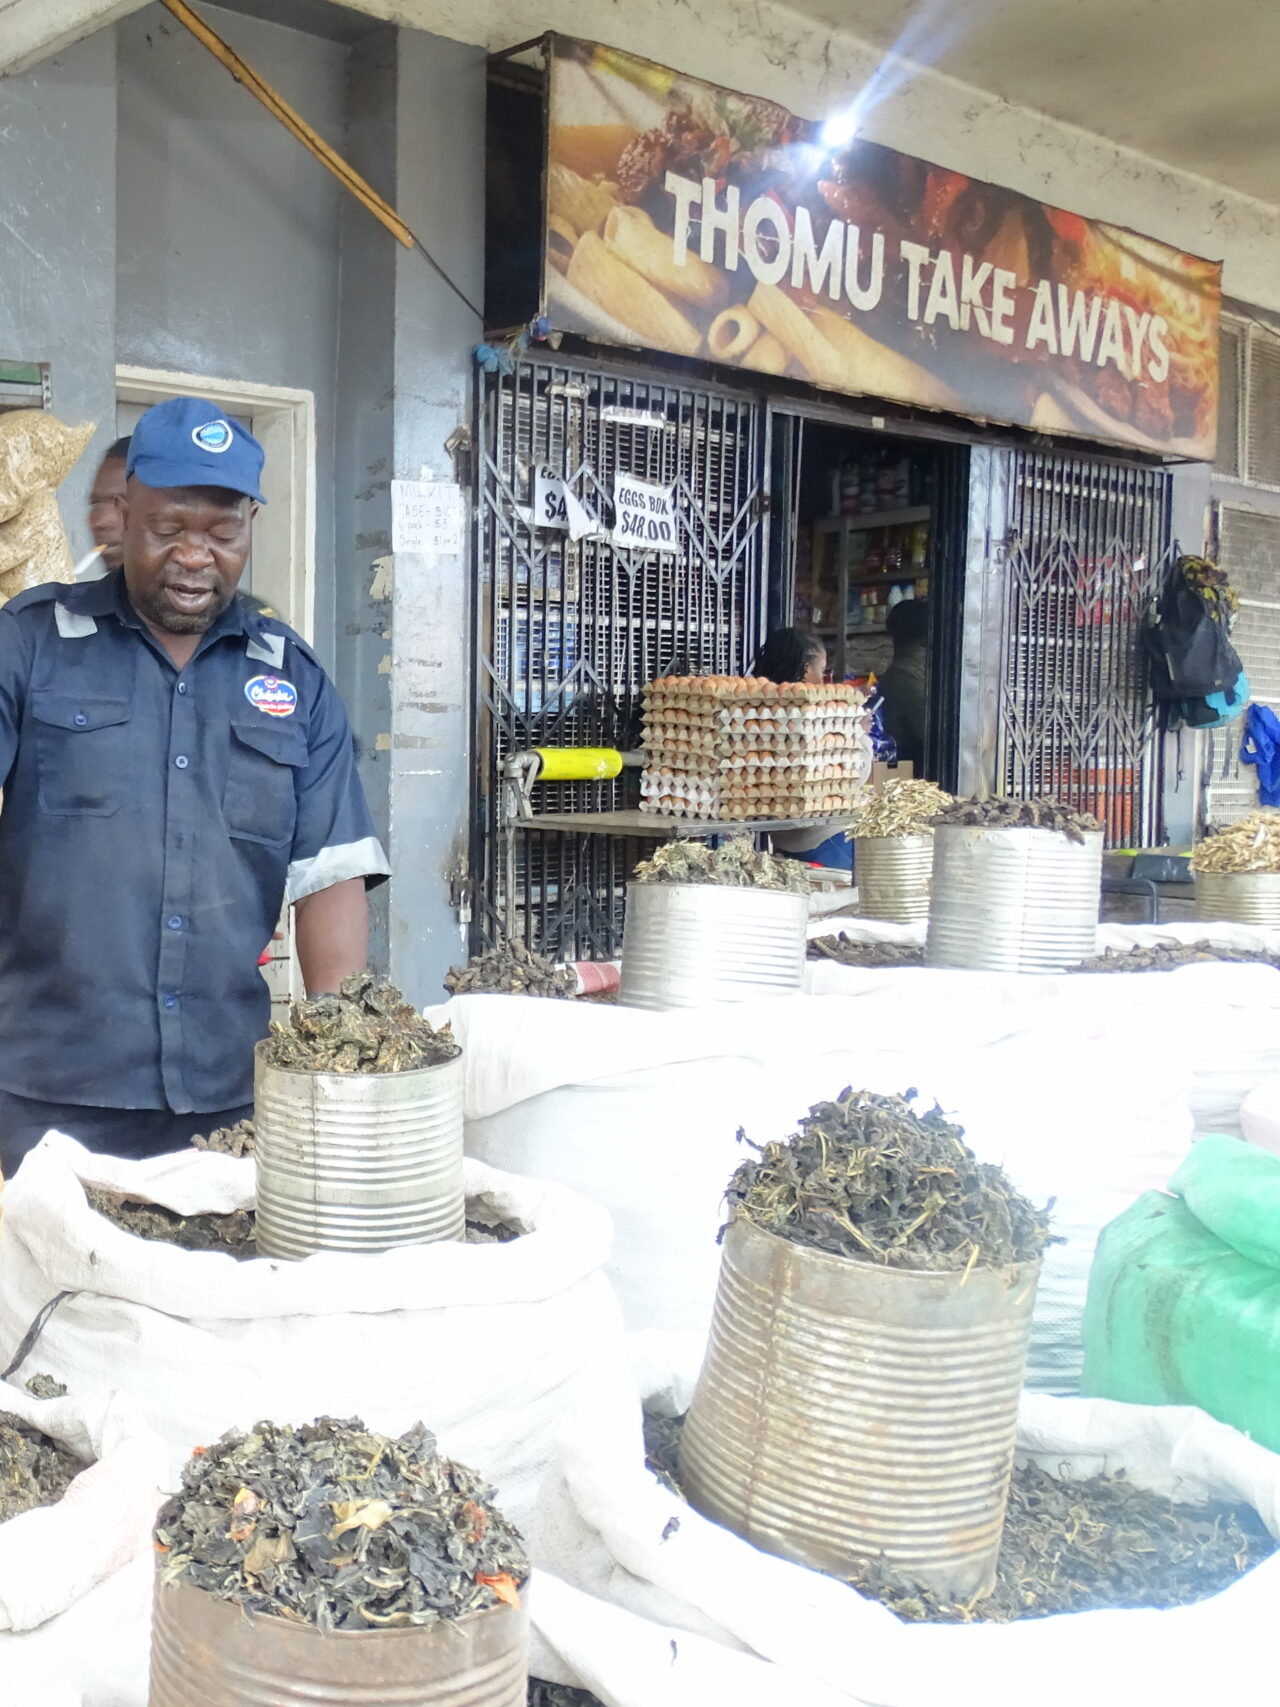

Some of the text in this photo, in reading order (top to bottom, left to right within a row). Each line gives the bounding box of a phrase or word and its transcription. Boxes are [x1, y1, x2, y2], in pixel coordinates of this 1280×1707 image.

[664, 169, 1170, 384] THOMU TAKE AWAYS
[618, 487, 670, 516] EGGS BOX
[621, 510, 671, 541] $48.00
